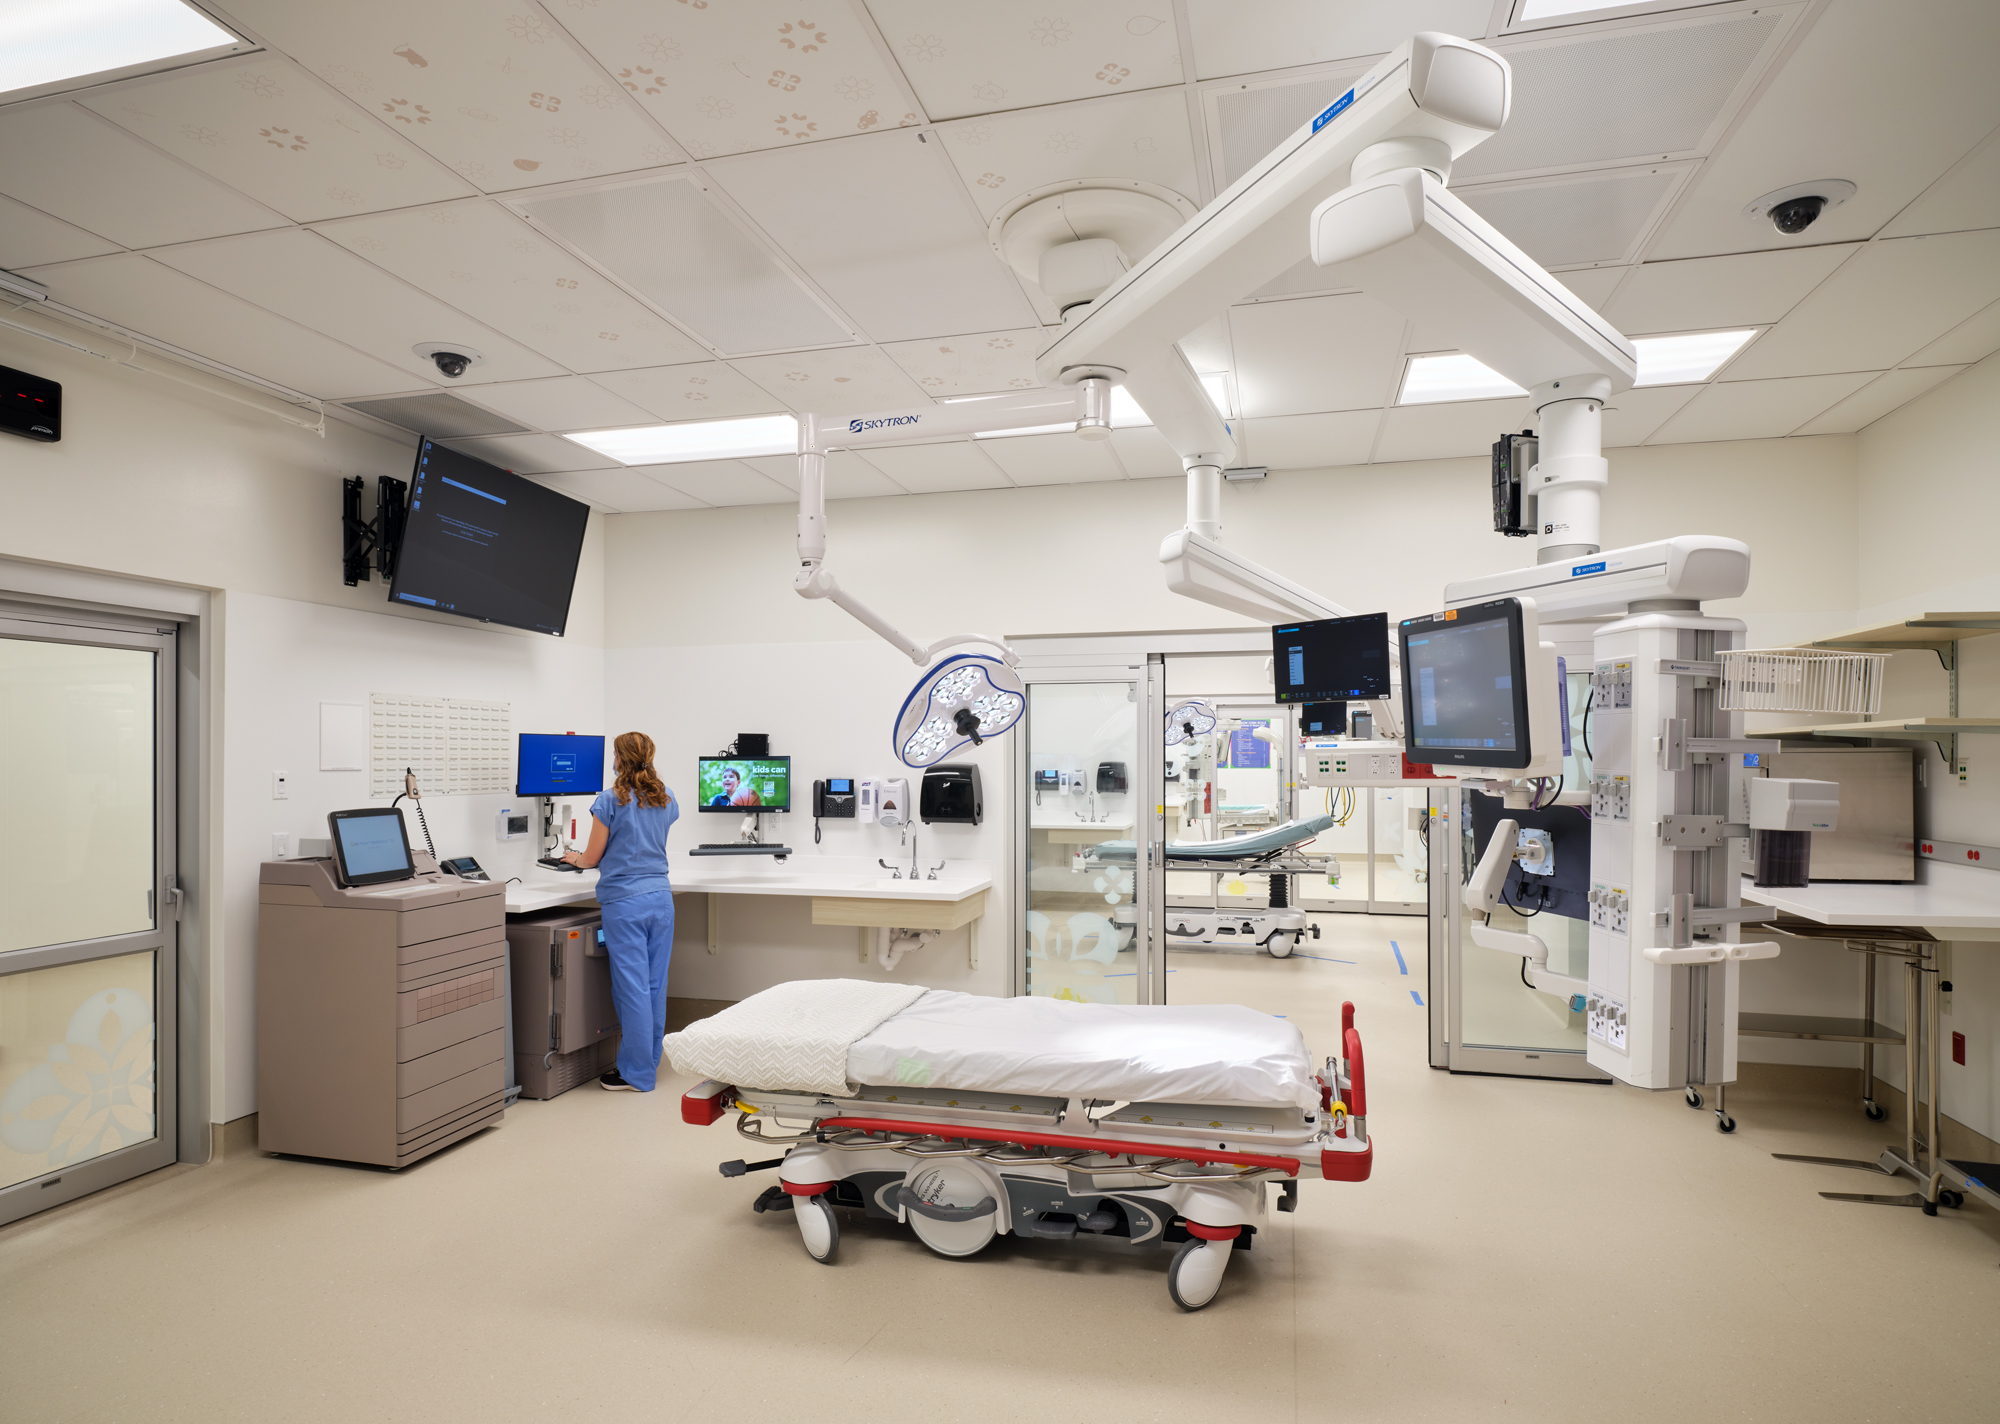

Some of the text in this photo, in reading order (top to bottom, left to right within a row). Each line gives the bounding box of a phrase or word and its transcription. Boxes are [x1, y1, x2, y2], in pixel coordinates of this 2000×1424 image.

[863, 415, 919, 430] SKYTRON
[752, 765, 786, 774] kids can
[928, 1179, 945, 1205] tryker
